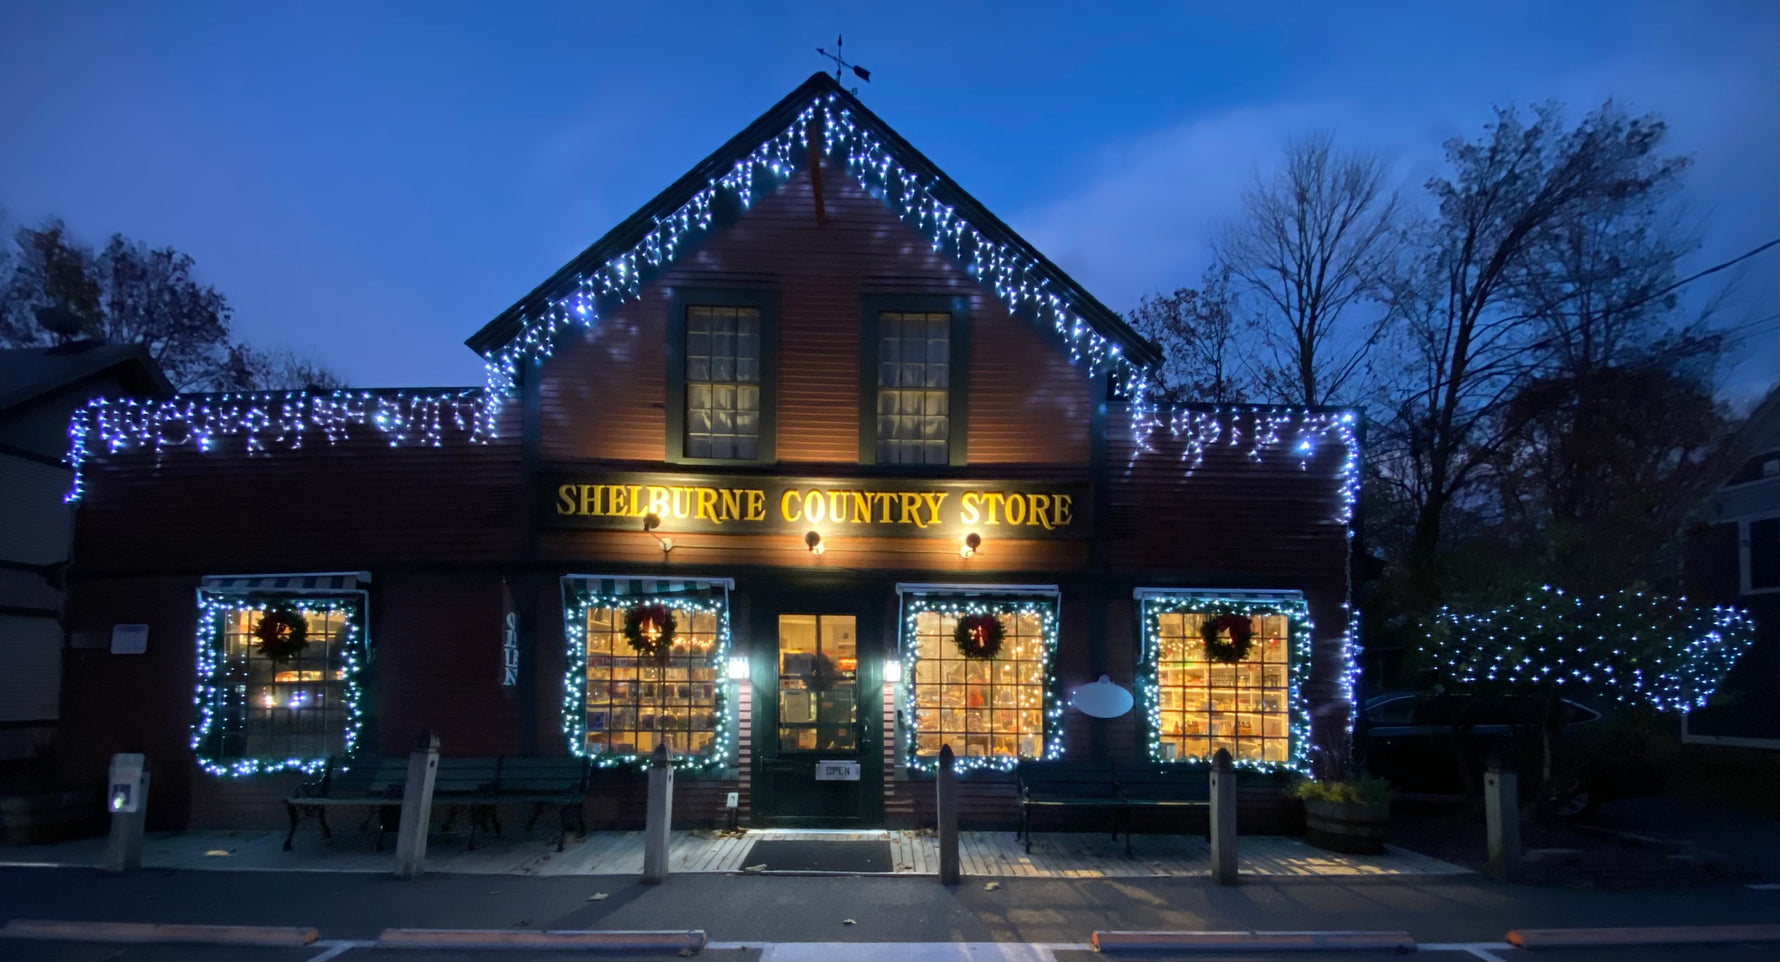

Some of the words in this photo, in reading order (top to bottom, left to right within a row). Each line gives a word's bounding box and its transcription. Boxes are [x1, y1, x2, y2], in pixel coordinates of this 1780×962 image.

[556, 484, 766, 524] SHELBURNE
[780, 489, 949, 529] COUNTRY
[960, 491, 1074, 530] STORE
[825, 766, 851, 776] OPEN
